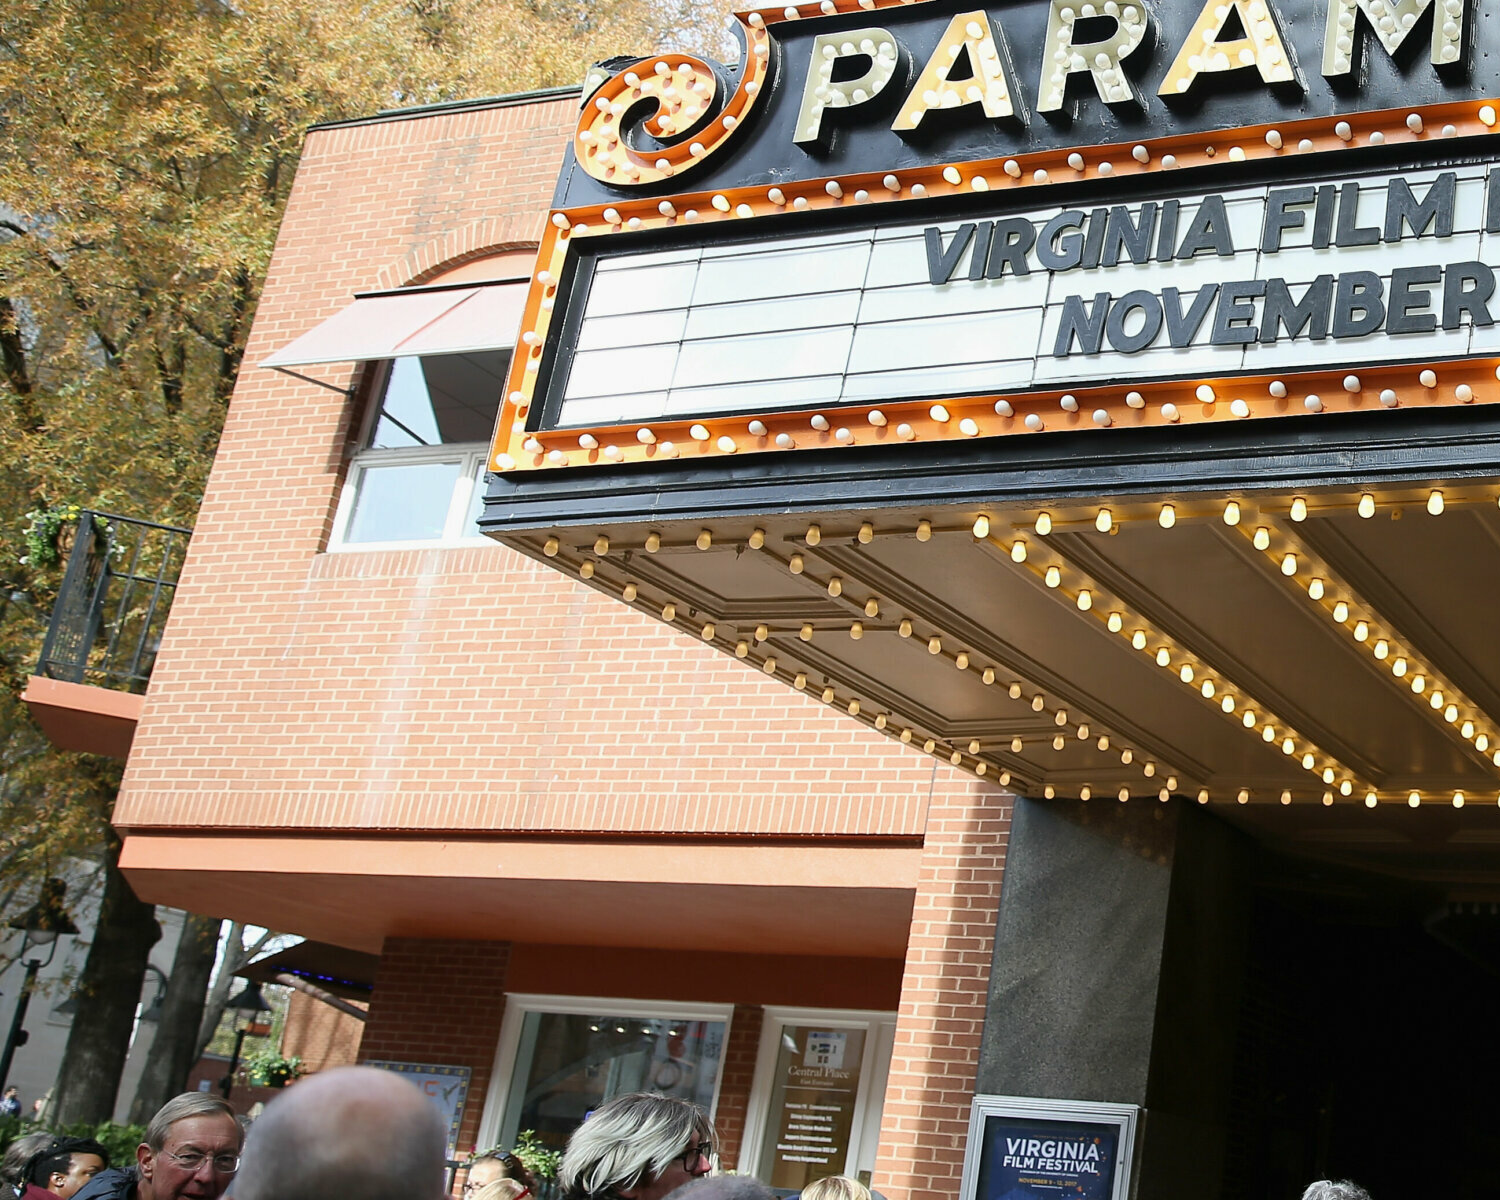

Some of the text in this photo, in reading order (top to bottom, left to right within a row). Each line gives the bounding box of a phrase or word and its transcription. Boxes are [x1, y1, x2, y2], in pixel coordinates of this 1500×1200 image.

[924, 195, 1236, 286] VIRGINIA
[1263, 173, 1457, 254] FILM
[1053, 261, 1496, 358] NOVEMBER
[787, 1065, 850, 1079] Central Place
[1006, 1137, 1100, 1161] VIRGINIA
[1003, 1155, 1035, 1169] FILM
[1037, 1158, 1098, 1174] FESTIVAL
[1018, 1177, 1048, 1185] NOVEMBER
